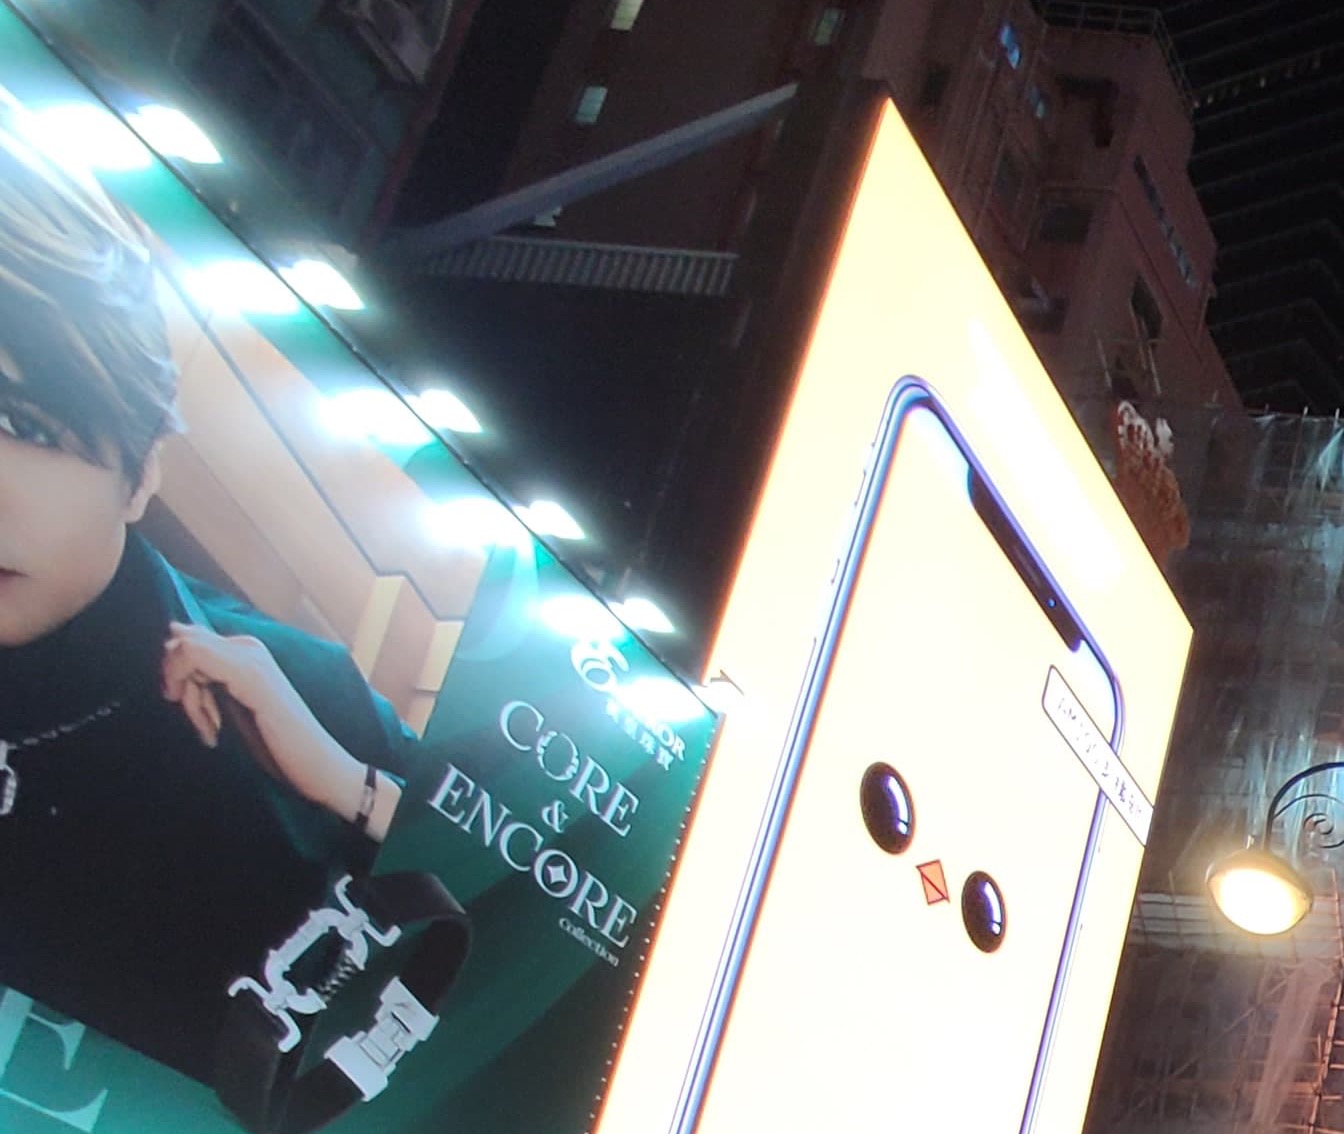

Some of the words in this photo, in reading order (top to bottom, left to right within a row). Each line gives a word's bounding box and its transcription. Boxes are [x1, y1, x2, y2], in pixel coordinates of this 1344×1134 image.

[500, 700, 640, 837] CORE
[541, 800, 569, 834] &
[427, 762, 638, 948] ENCORE
